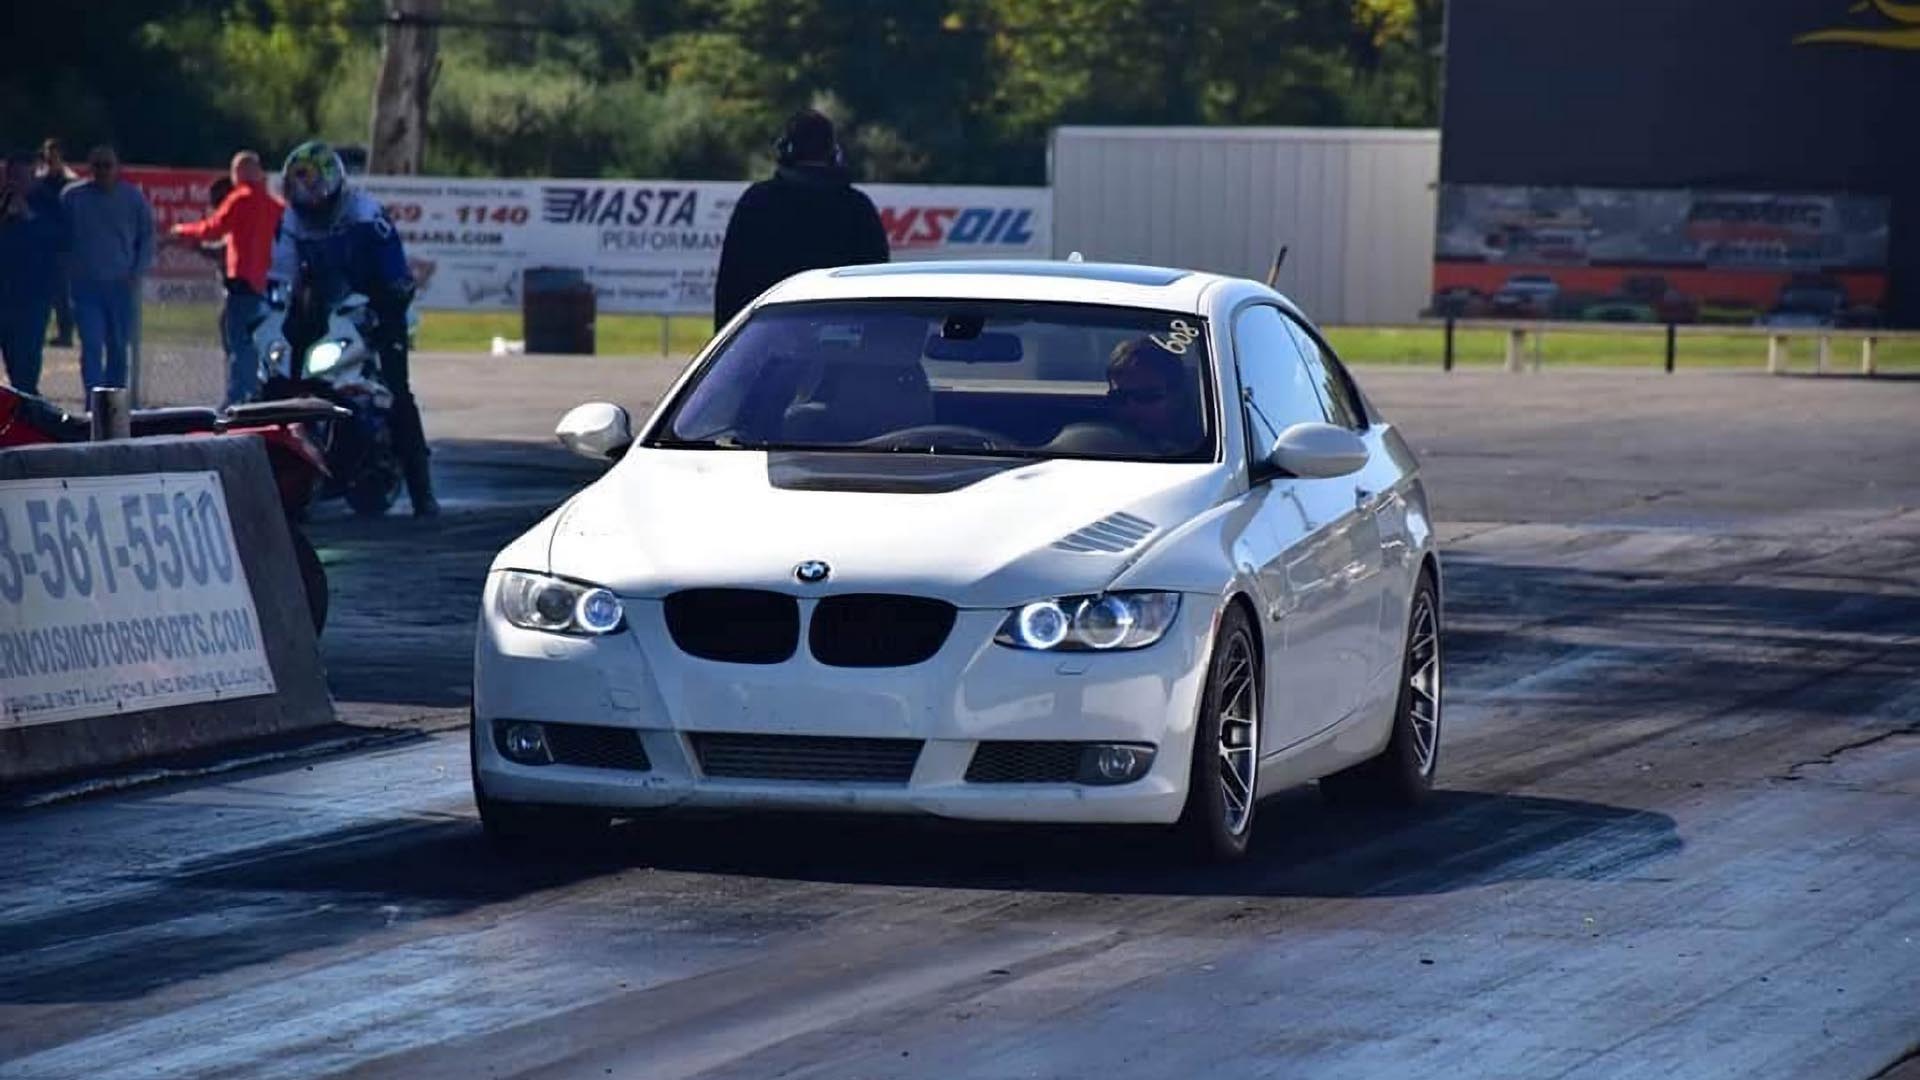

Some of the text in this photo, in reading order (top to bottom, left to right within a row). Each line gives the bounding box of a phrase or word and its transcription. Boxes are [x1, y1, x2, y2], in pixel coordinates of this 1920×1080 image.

[456, 205, 528, 224] 1140
[541, 188, 697, 225] MASTA
[602, 231, 724, 251] PERFORMAN
[880, 208, 1033, 243] MSOIL
[1149, 319, 1200, 355] 608
